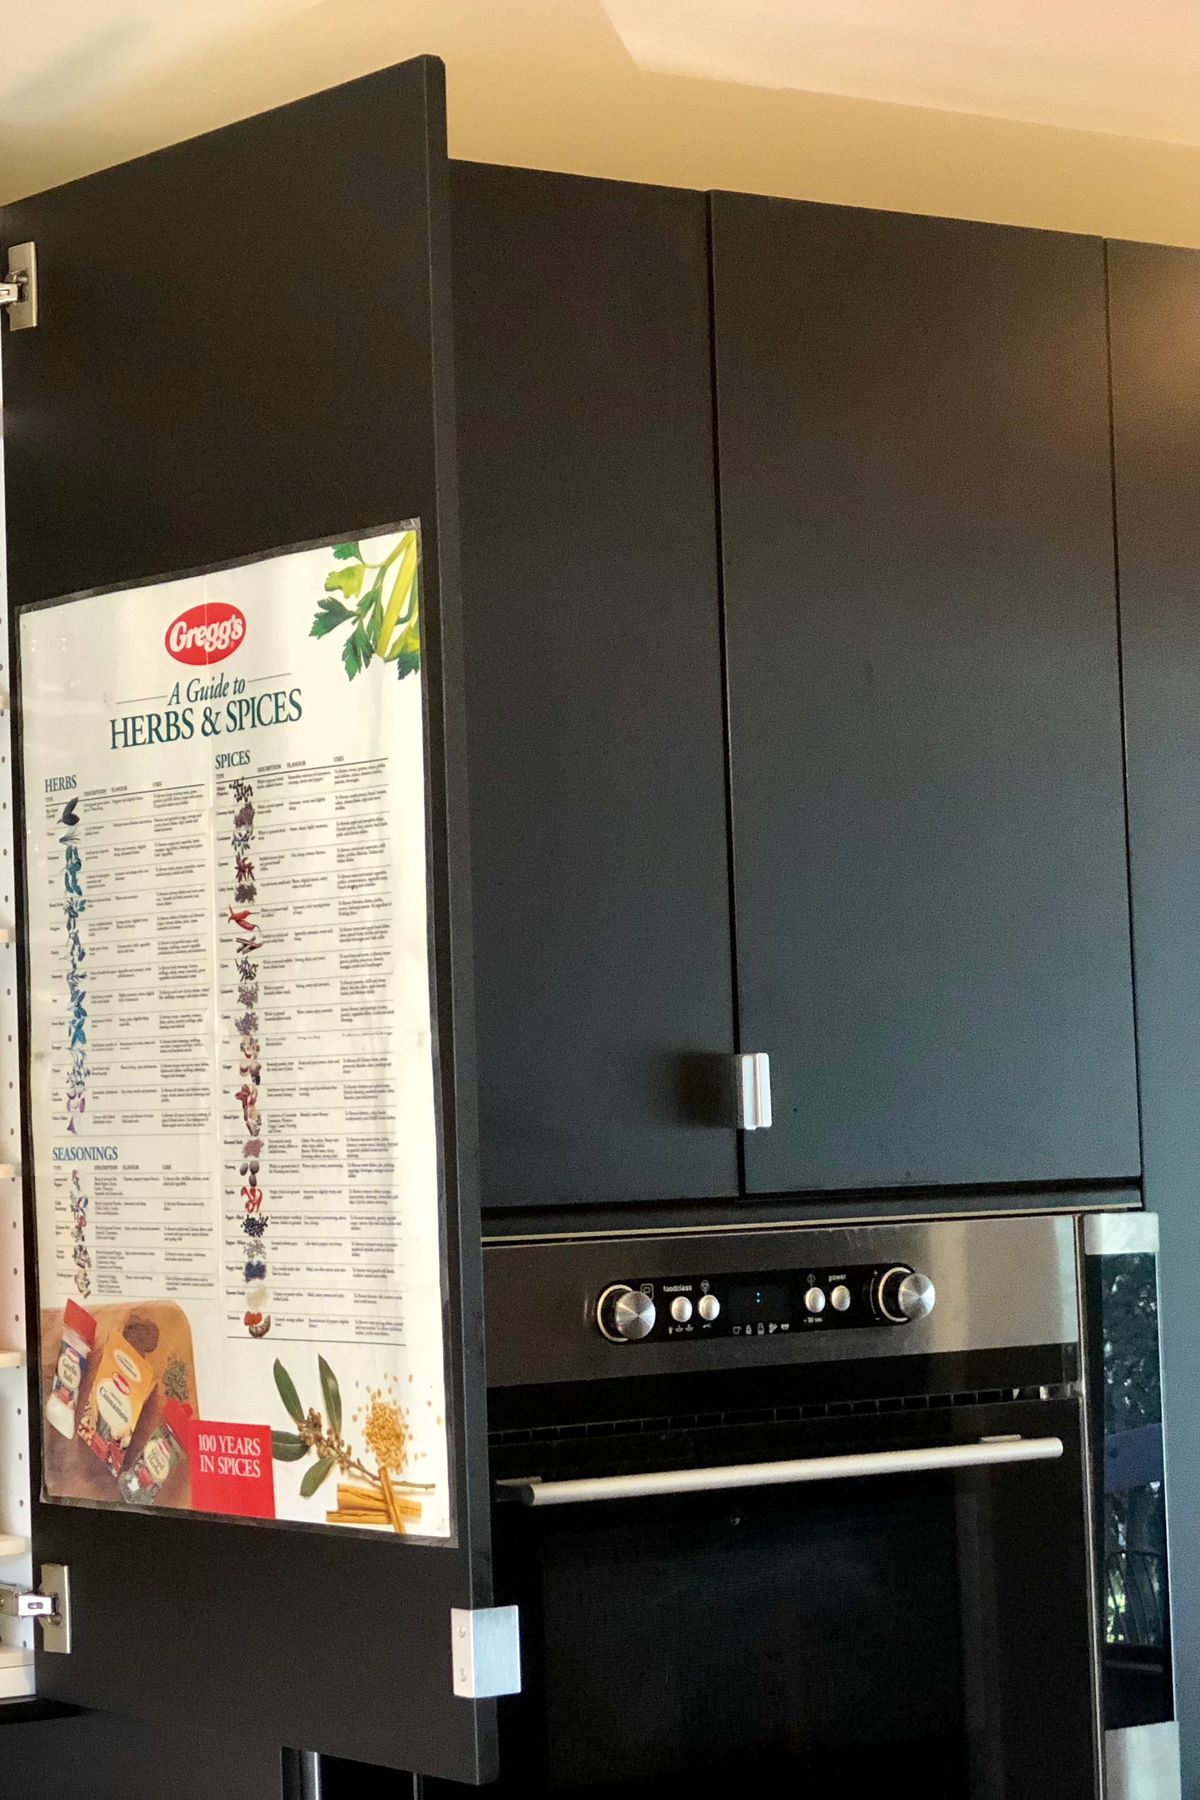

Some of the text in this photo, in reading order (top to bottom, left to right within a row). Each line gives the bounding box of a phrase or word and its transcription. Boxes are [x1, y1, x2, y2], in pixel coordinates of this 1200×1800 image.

[169, 614, 244, 653] Gregg's
[167, 673, 246, 705] A Guide to
[110, 688, 302, 750] HERBS & SPICES
[215, 749, 251, 769] SPICES
[44, 775, 77, 793] HERBS
[52, 1146, 119, 1161] SEASONINGS
[828, 1274, 847, 1283] power
[198, 1434, 261, 1457] 100 YEARS
[200, 1454, 261, 1478] IN SPICES
